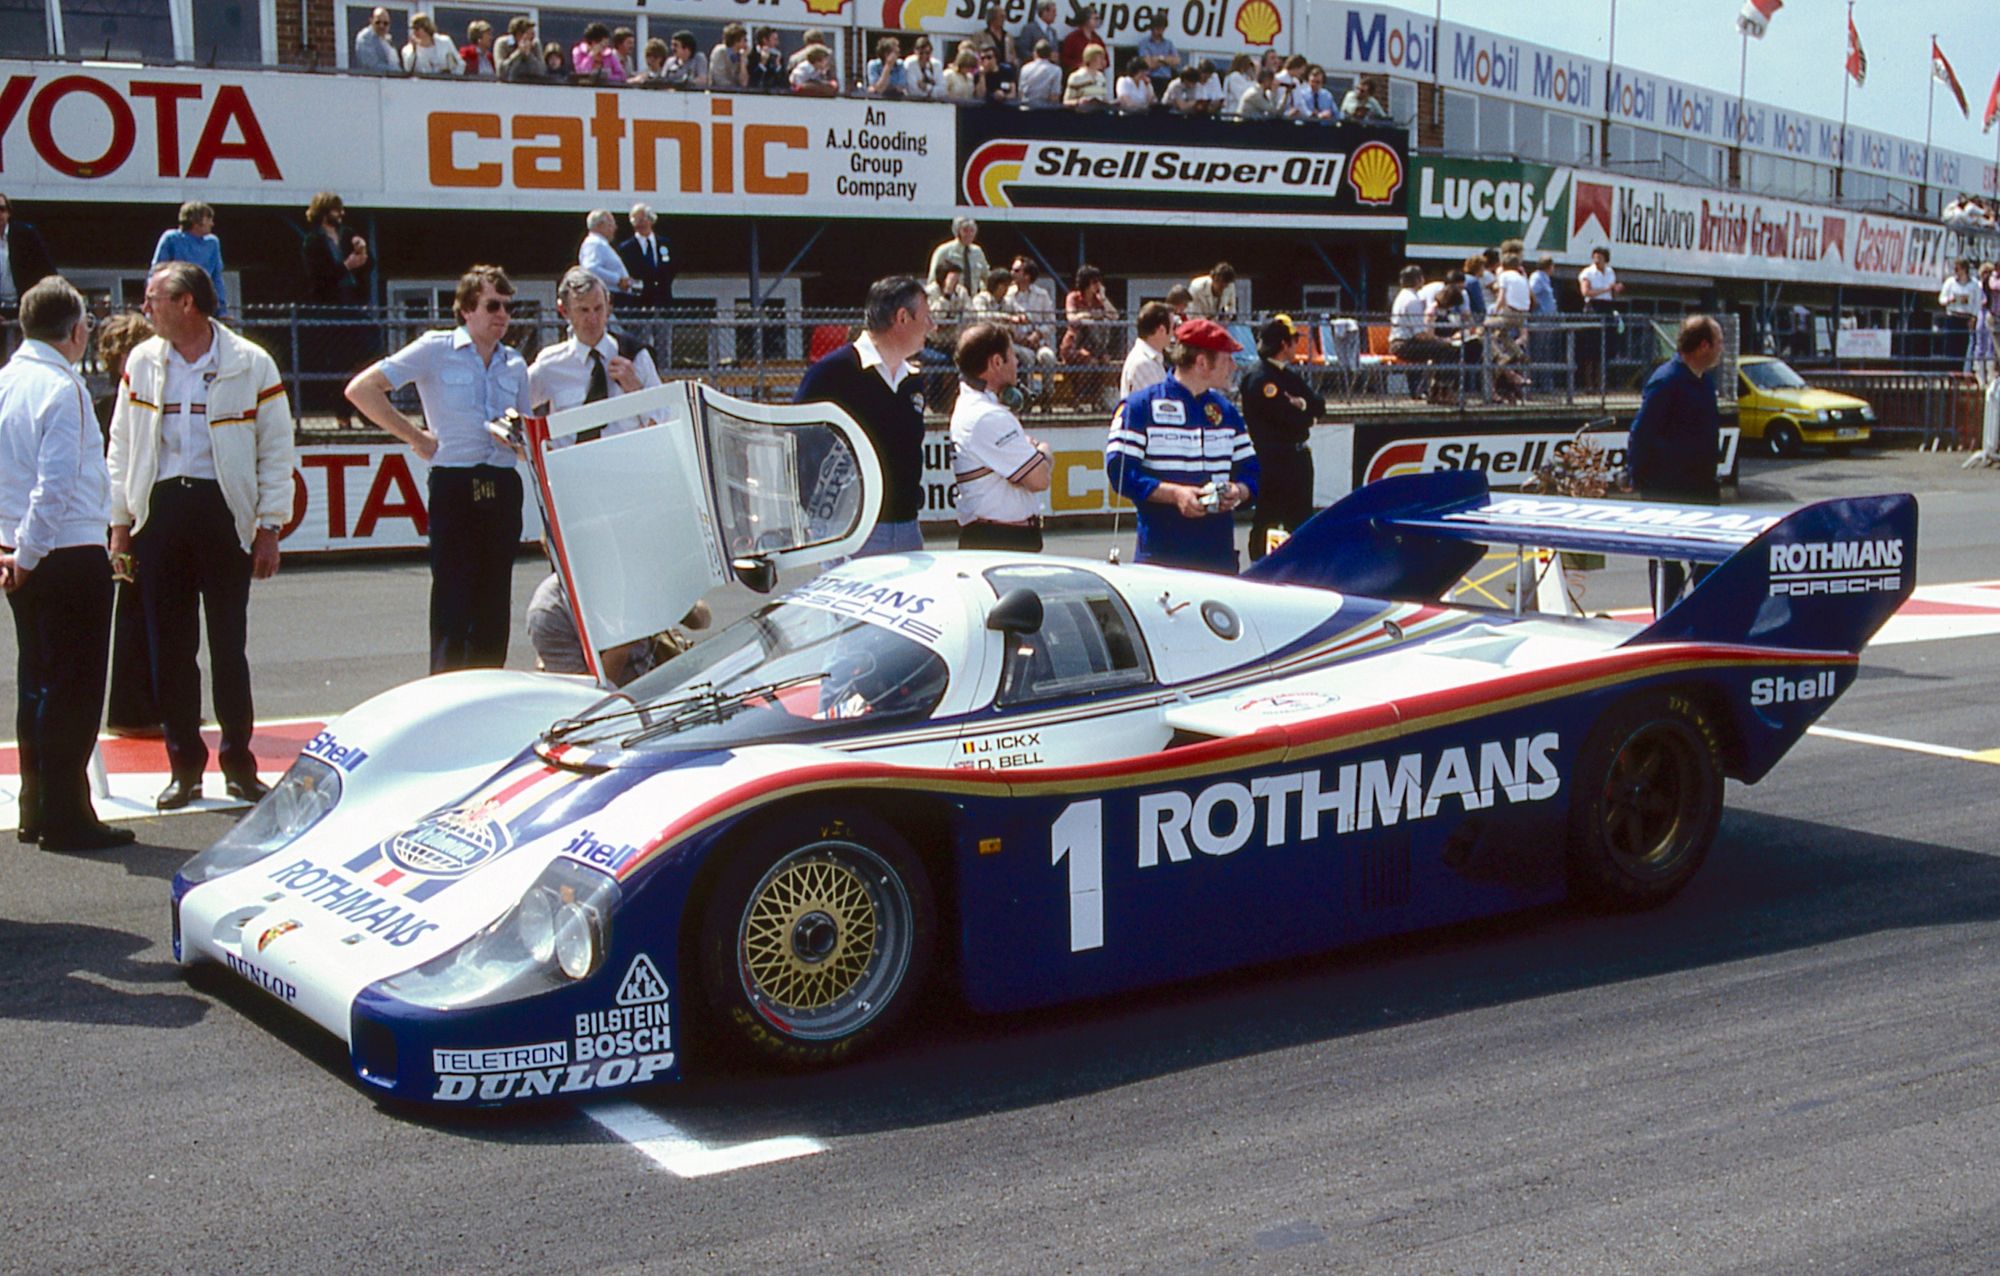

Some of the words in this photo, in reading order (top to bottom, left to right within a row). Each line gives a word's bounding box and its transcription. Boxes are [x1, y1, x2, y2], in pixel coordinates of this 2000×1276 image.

[1183, 0, 1229, 37] Oil
[865, 105, 886, 126] An
[1454, 32, 1518, 91] Mobil
[1534, 52, 1591, 107] Mobil
[1610, 71, 1655, 121] Mobil
[1666, 86, 1713, 135] Mobil
[1723, 101, 1764, 143] Mobil
[1773, 113, 1811, 154] Mobil
[1819, 123, 1855, 164] Moil
[427, 93, 808, 194] catnic
[826, 128, 857, 149] A.J.
[859, 130, 928, 156] Gooding
[850, 152, 903, 177] Group
[1034, 147, 1149, 179] Shell
[1151, 152, 1278, 184] Super
[1281, 157, 1337, 186] Oil
[837, 175, 917, 201] Company
[1419, 167, 1535, 222] Lucas
[1616, 187, 1694, 250] Marlboro
[1699, 200, 1748, 255] British
[1750, 206, 1790, 258] Grand
[1792, 211, 1819, 261] Prix
[1854, 217, 1908, 272] Castrol
[1907, 227, 1943, 277] GTX
[1435, 441, 1547, 473] Shell
[282, 454, 430, 538] TA
[1769, 539, 1904, 572] ROTHMANS
[803, 577, 935, 614] THMANS
[1769, 576, 1901, 597] PORSCHE
[781, 592, 943, 643] RSCHE
[1750, 671, 1835, 705] Shell
[304, 731, 369, 773] Shell
[979, 739, 992, 752] J.
[996, 733, 1040, 750] ICKX
[978, 759, 995, 771] D.
[1000, 752, 1044, 768] BELL
[1138, 732, 1560, 868] ROTHMANS
[1052, 799, 1103, 952] 1
[268, 859, 439, 946] ROTHMANS
[226, 951, 296, 1003] DUNLOP
[576, 1003, 669, 1036] BILSTEIN
[437, 1047, 565, 1071] TELETRON
[576, 1026, 671, 1061] BOSCH
[433, 1053, 674, 1100] DUNLOP
